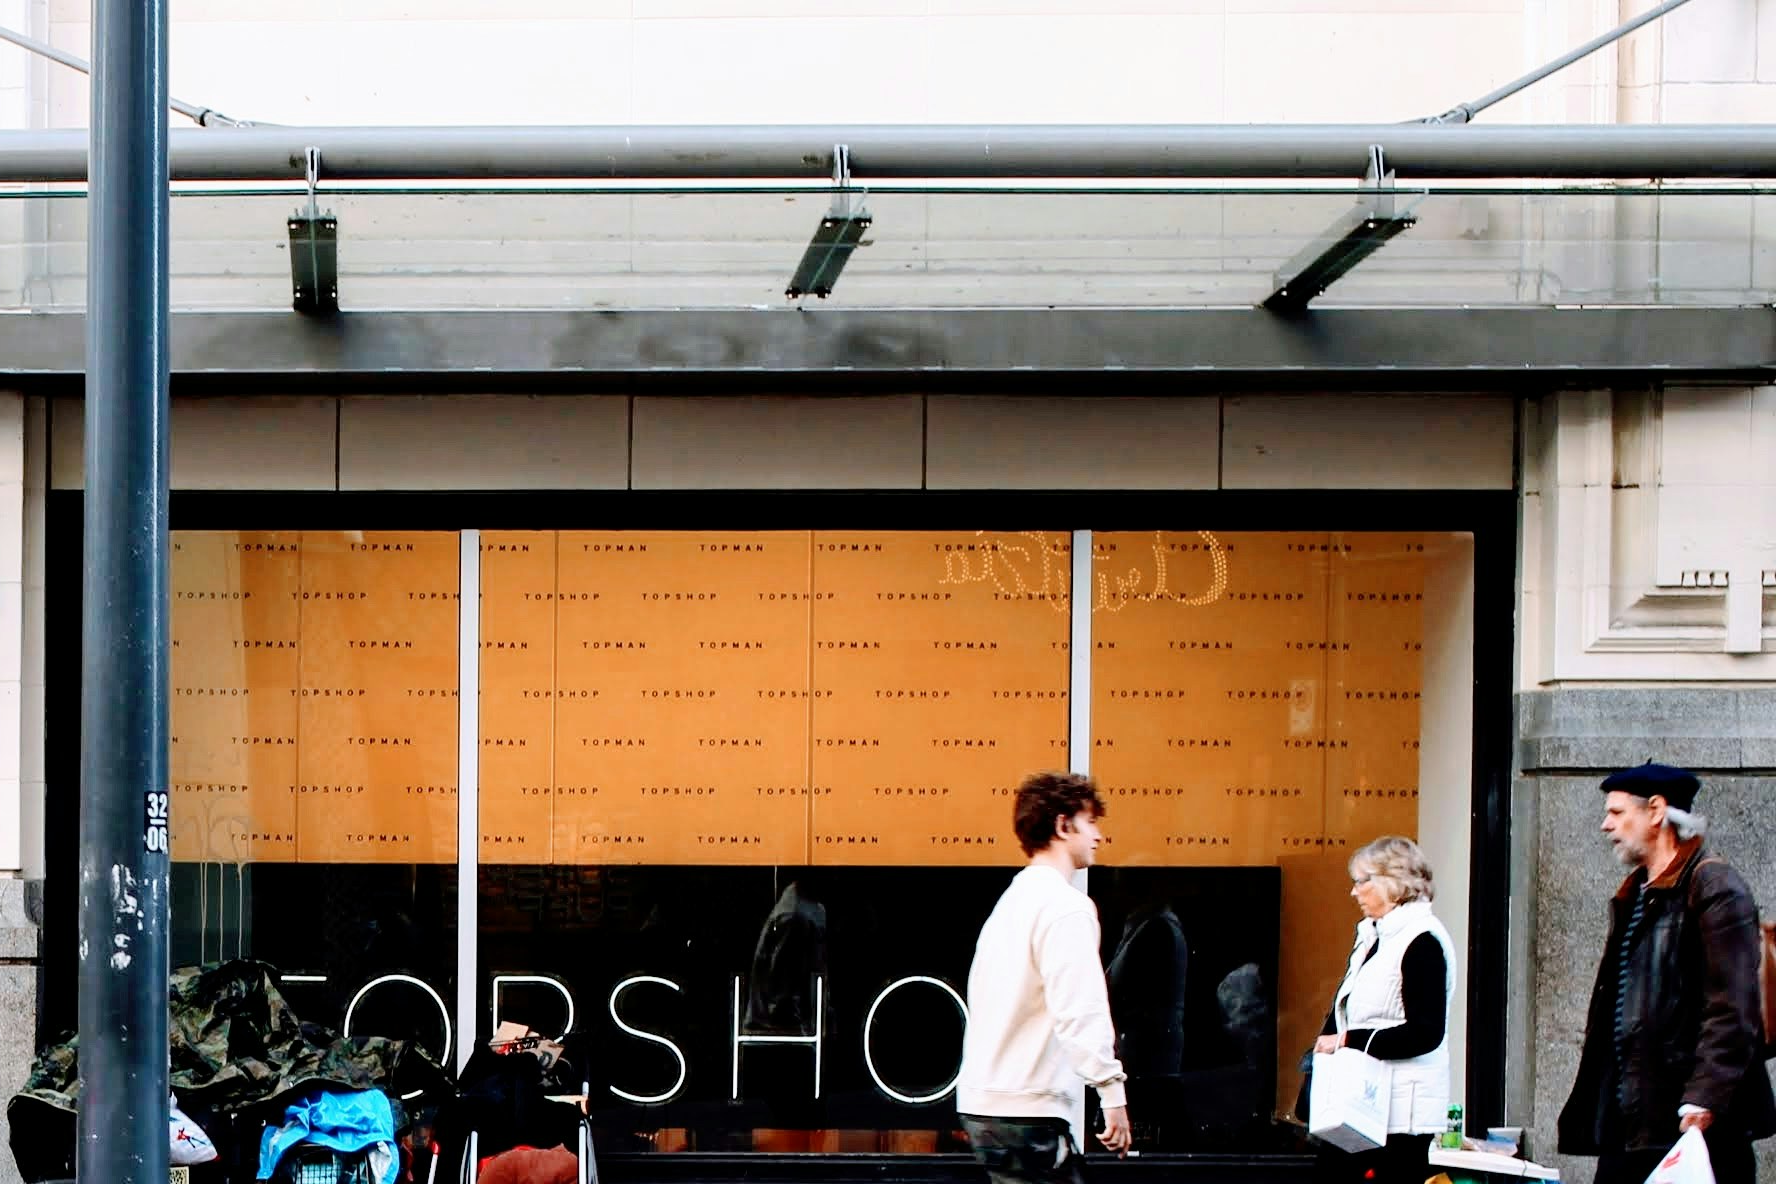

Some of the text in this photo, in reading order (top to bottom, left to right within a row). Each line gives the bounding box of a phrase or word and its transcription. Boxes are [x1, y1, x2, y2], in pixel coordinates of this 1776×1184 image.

[236, 543, 297, 552] TOPMAN
[351, 543, 413, 552] TOPMAN
[479, 543, 528, 552] PMAN
[584, 543, 646, 552] TOPMAN
[701, 543, 763, 552] TOPMAN
[819, 543, 881, 552] TOPMAN
[1289, 543, 1351, 552] TOPMAN
[178, 591, 250, 600] TOPSHOP
[292, 591, 366, 600] TOPSHOP
[525, 592, 599, 601] TOPSHOP
[643, 592, 717, 601] TOPSHOP
[759, 592, 834, 601] TOPSHOP
[877, 592, 951, 601] TOPSHOP
[1229, 592, 1304, 601] TOPSHOP
[1348, 593, 1424, 602] TOPSHOP
[234, 640, 296, 649] TOPMAN
[349, 641, 411, 649] TOPMAN
[479, 641, 528, 650] PMAN
[583, 641, 646, 650] TOPMAN
[699, 641, 762, 650] TOPMAN
[817, 641, 880, 649] TOPMAN
[934, 641, 998, 649] TOPMAN
[1170, 641, 1233, 650] TOPMAN
[1287, 641, 1349, 650] TOPMAN
[176, 688, 248, 697] TOPSHOP
[291, 688, 365, 697] TOPSHOP
[523, 689, 599, 698] TOPSHOP
[642, 689, 716, 698] TOPSHOP
[759, 689, 832, 698] TOPSHOP
[876, 689, 950, 698] TOPSHOP
[994, 690, 1068, 699] TOPSHOP
[1111, 690, 1185, 699] TOPSHOP
[1228, 690, 1302, 699] TOPSHOP
[1346, 691, 1420, 700] TOPSHOP
[232, 736, 295, 745] TOPMAN
[348, 737, 410, 746] TOPMAN
[583, 738, 645, 747] TOPMAN
[699, 738, 761, 747] TOPMAN
[817, 738, 879, 747] TOPMAN
[932, 738, 996, 747] TOPMAN
[1168, 739, 1231, 748] TOPMAN
[1285, 739, 1348, 748] TOPMAN
[176, 784, 248, 793] TOPSHOP
[290, 785, 363, 794] TOPSHOP
[522, 786, 597, 795] TOPSHOP
[641, 787, 715, 796] TOPSHOP
[758, 787, 831, 796] TOPSHOP
[875, 787, 949, 796] TOPSHOP
[1109, 788, 1184, 797] TOPSHOP
[1227, 788, 1301, 797] TOPSHOP
[1344, 788, 1419, 798] TOPSHOP
[147, 793, 168, 817] 32
[146, 826, 168, 851] 06
[347, 833, 409, 842] TOPMAN
[484, 835, 525, 844] PMAN
[582, 835, 644, 844] TOPMAN
[698, 835, 760, 844] TOPMAN
[816, 835, 878, 844] TOPMAN
[932, 836, 995, 845] TOPMAN
[1166, 836, 1229, 845] TOPMAN
[1282, 837, 1345, 846] TOPMAN
